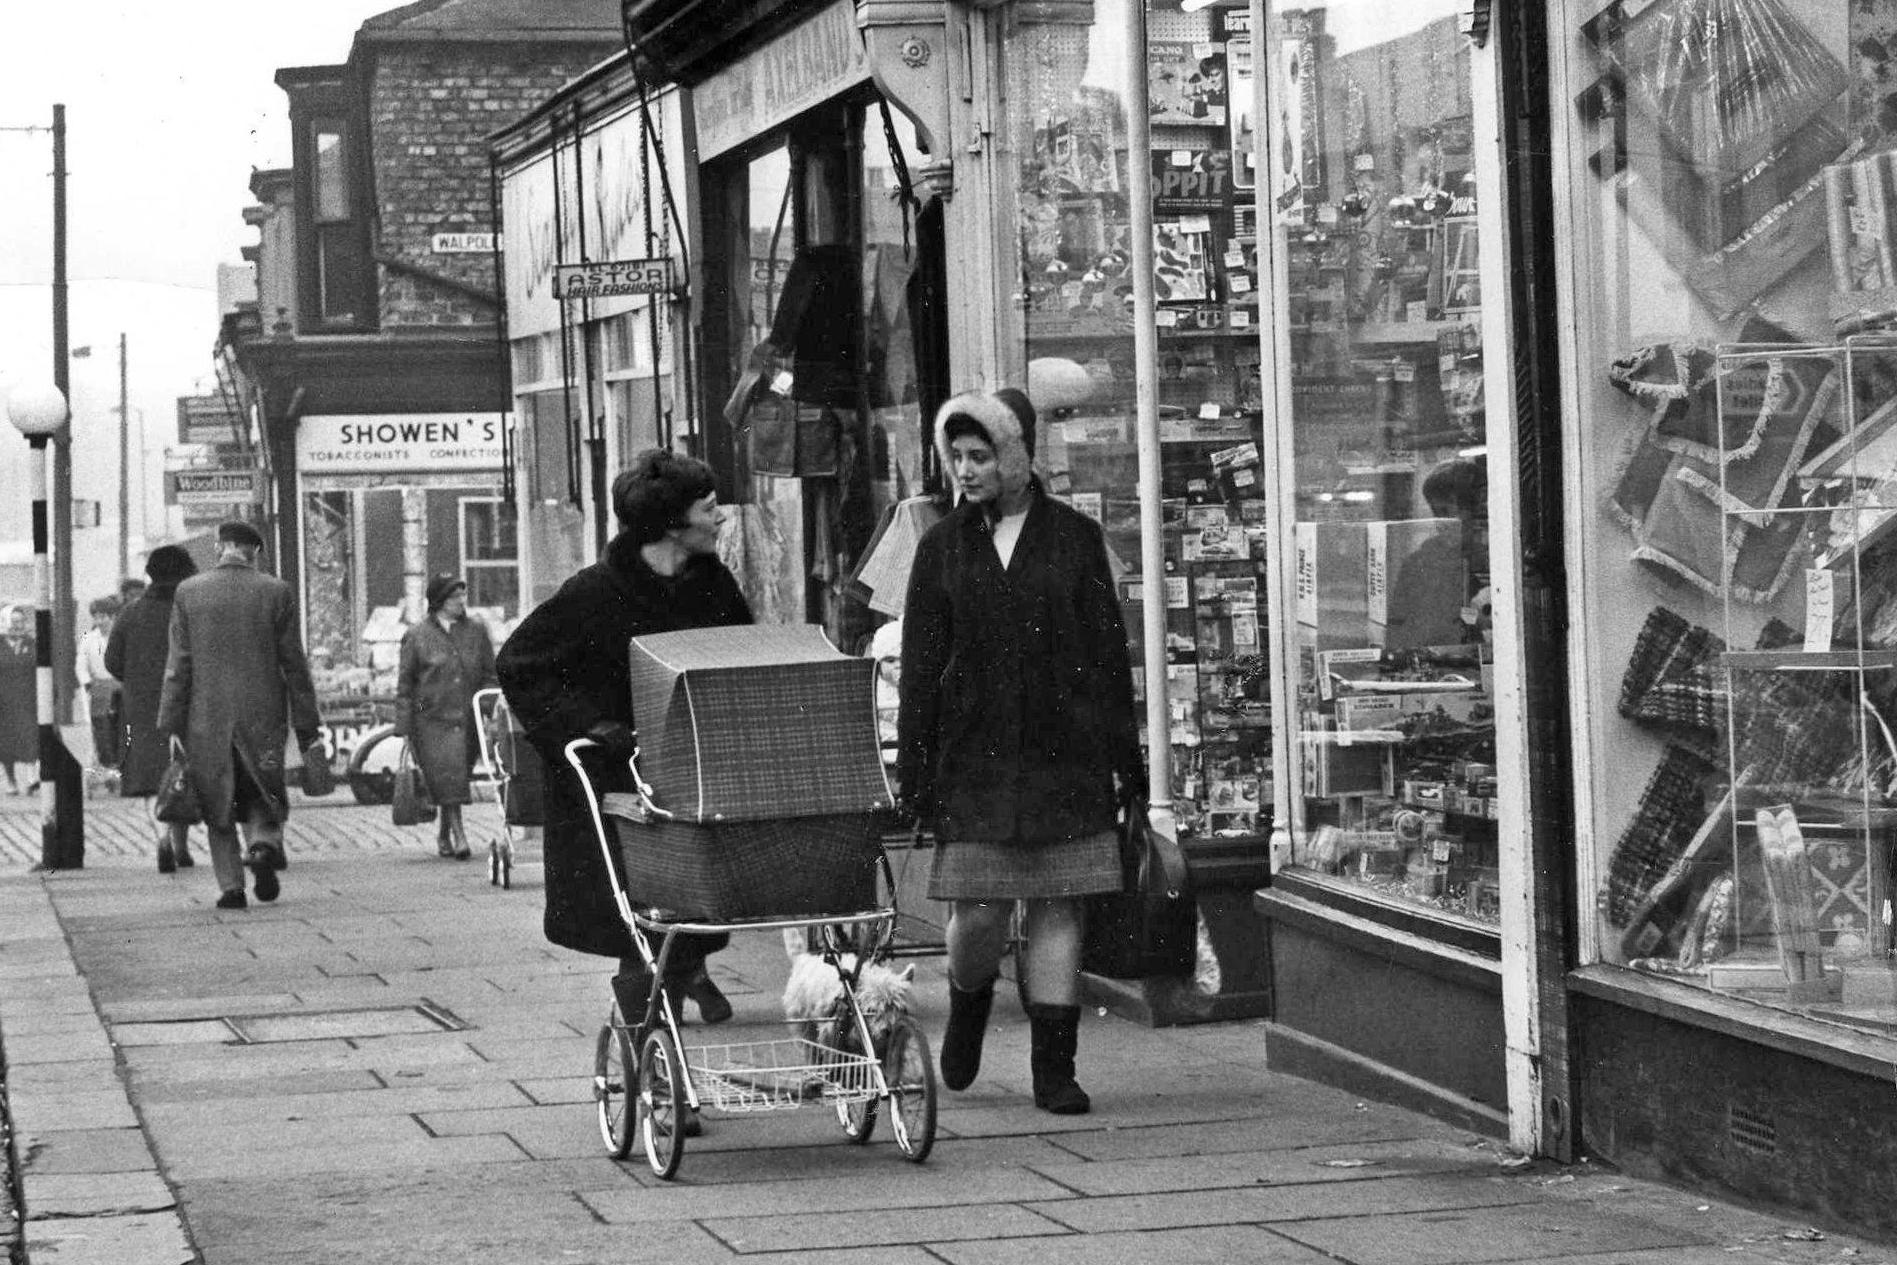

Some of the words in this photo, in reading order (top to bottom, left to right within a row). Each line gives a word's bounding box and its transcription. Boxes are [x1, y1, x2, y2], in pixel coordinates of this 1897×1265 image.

[568, 268, 662, 286] ASTOR
[567, 284, 600, 299] HAIR
[602, 281, 663, 295] FASHIONS
[341, 418, 495, 444] SHOWEN'S
[309, 449, 410, 461] TOBACCONISTS
[179, 476, 251, 491] Woodbine
